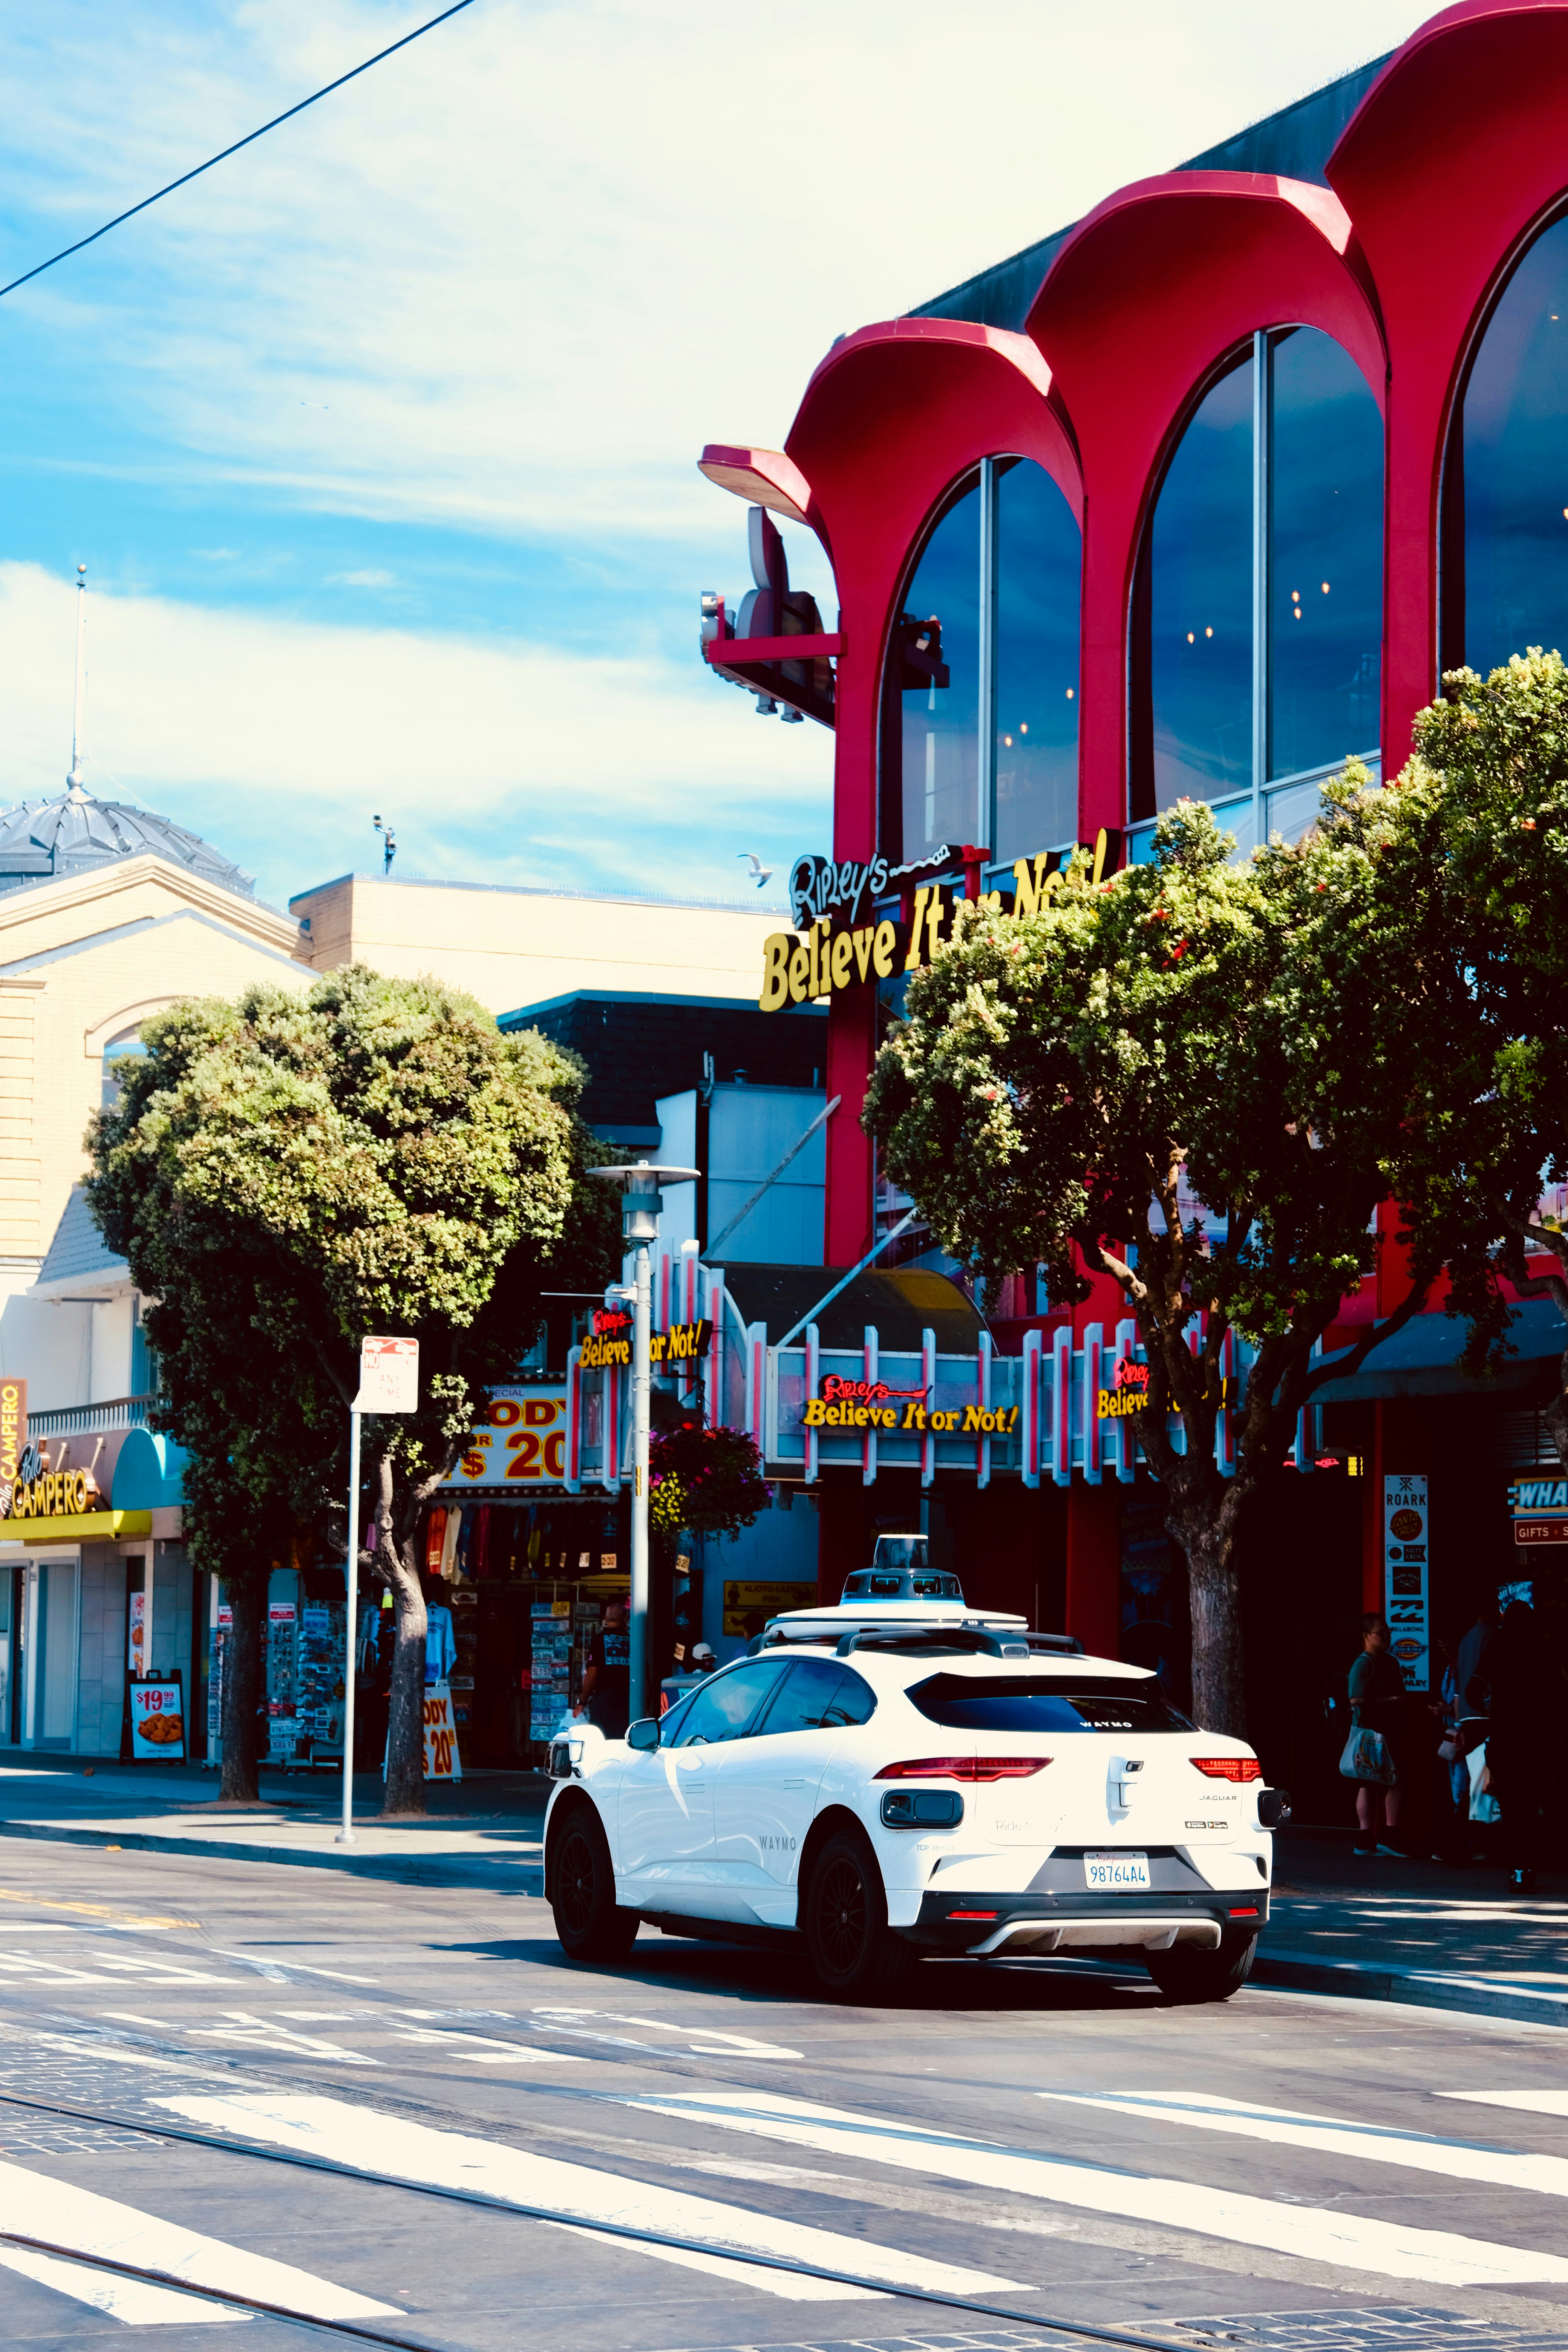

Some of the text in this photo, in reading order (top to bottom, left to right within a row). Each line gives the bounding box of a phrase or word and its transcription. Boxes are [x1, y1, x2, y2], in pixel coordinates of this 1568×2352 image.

[789, 852, 888, 931] Ripley's
[759, 917, 896, 1012] Believe
[905, 884, 944, 970] It
[579, 1318, 703, 1368] Believe or Not!
[364, 1352, 379, 1368] NO
[380, 1374, 401, 1384] ANY
[378, 1387, 401, 1398] TIME
[803, 1399, 1018, 1433] Believe It or Not!
[1, 1384, 18, 1481] CAMPERO
[12, 1468, 87, 1518] CAMPERO
[1387, 1494, 1426, 1506] ROARK
[1390, 1511, 1418, 1528] SANTA
[1396, 1522, 1418, 1537] CRUZ
[1519, 1527, 1549, 1538] GIFTS
[1404, 1680, 1427, 1688] NLEY
[430, 1729, 452, 1775] 20
[996, 1820, 1022, 1831] Ride
[759, 1836, 796, 1851] WAYMO
[1090, 1866, 1146, 1882] 98764A4
